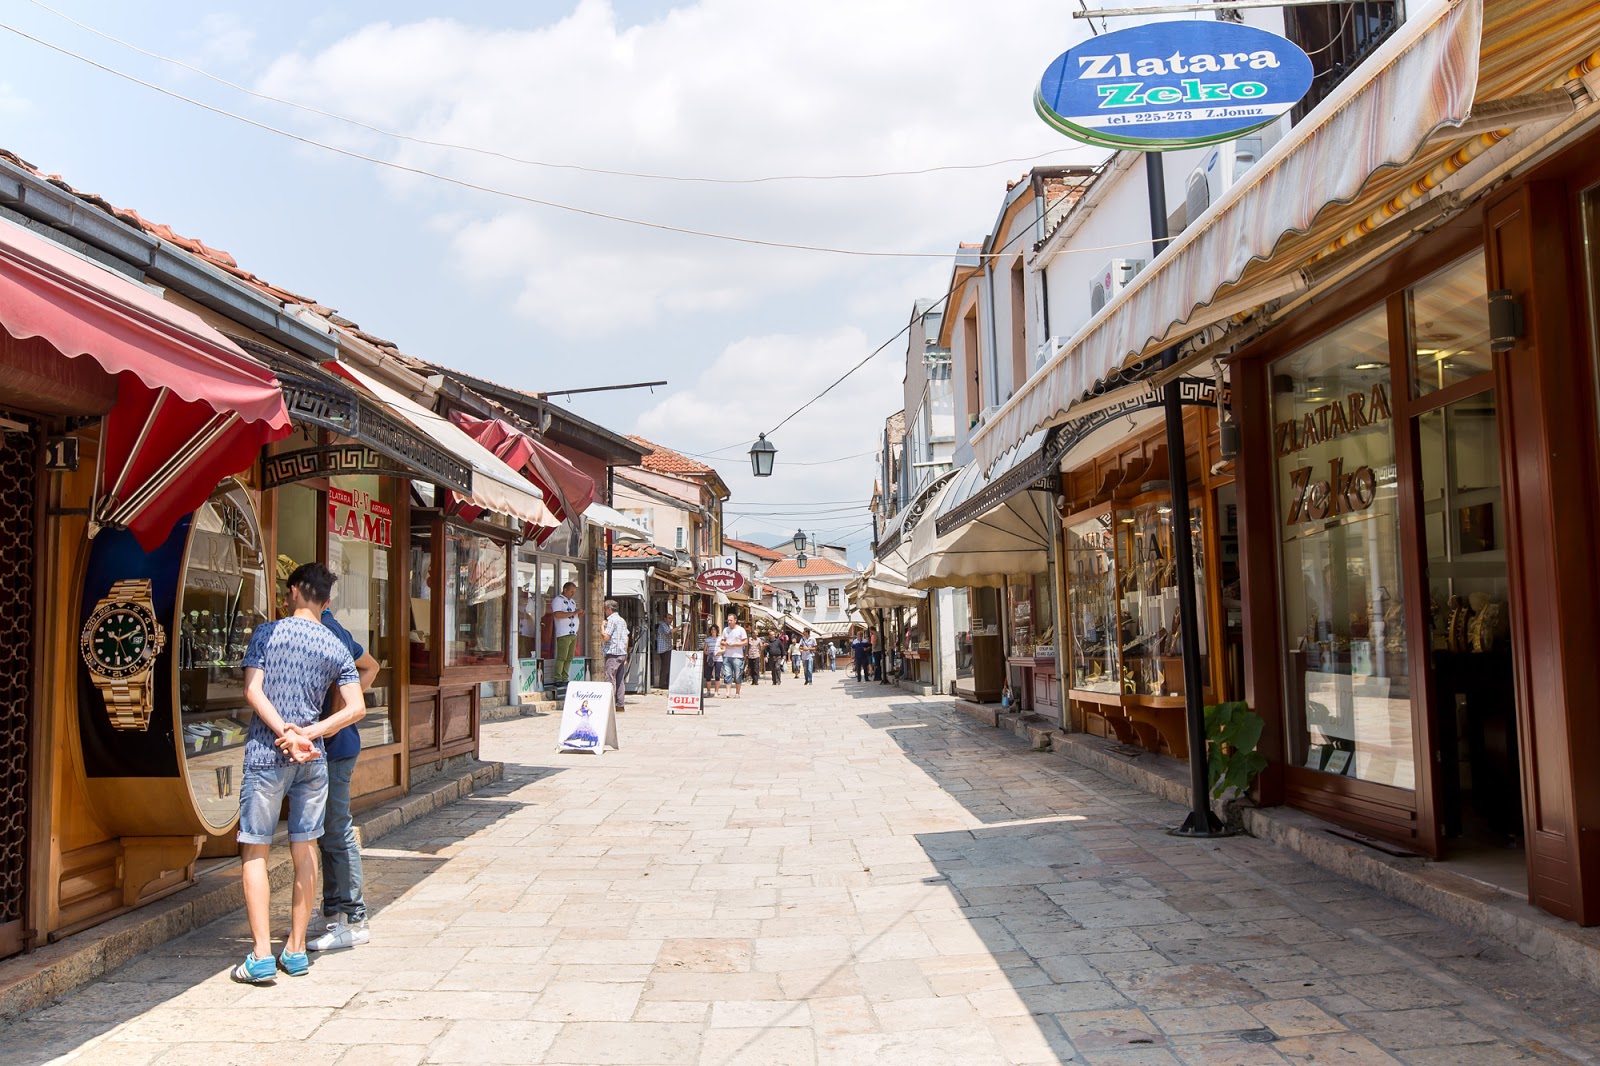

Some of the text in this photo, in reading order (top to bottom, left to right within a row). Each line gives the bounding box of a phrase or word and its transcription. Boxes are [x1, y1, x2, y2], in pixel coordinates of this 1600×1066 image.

[1078, 50, 1281, 80] Zlatara
[1097, 78, 1268, 109] Zeko
[1107, 106, 1264, 125] tel. 225-273 Z.Jonuz
[1274, 383, 1392, 459] ZLATARA
[329, 489, 351, 504] ZLATARA
[1286, 457, 1377, 526] Zeko
[329, 503, 392, 548] LAMI
[706, 579, 735, 587] DIAN
